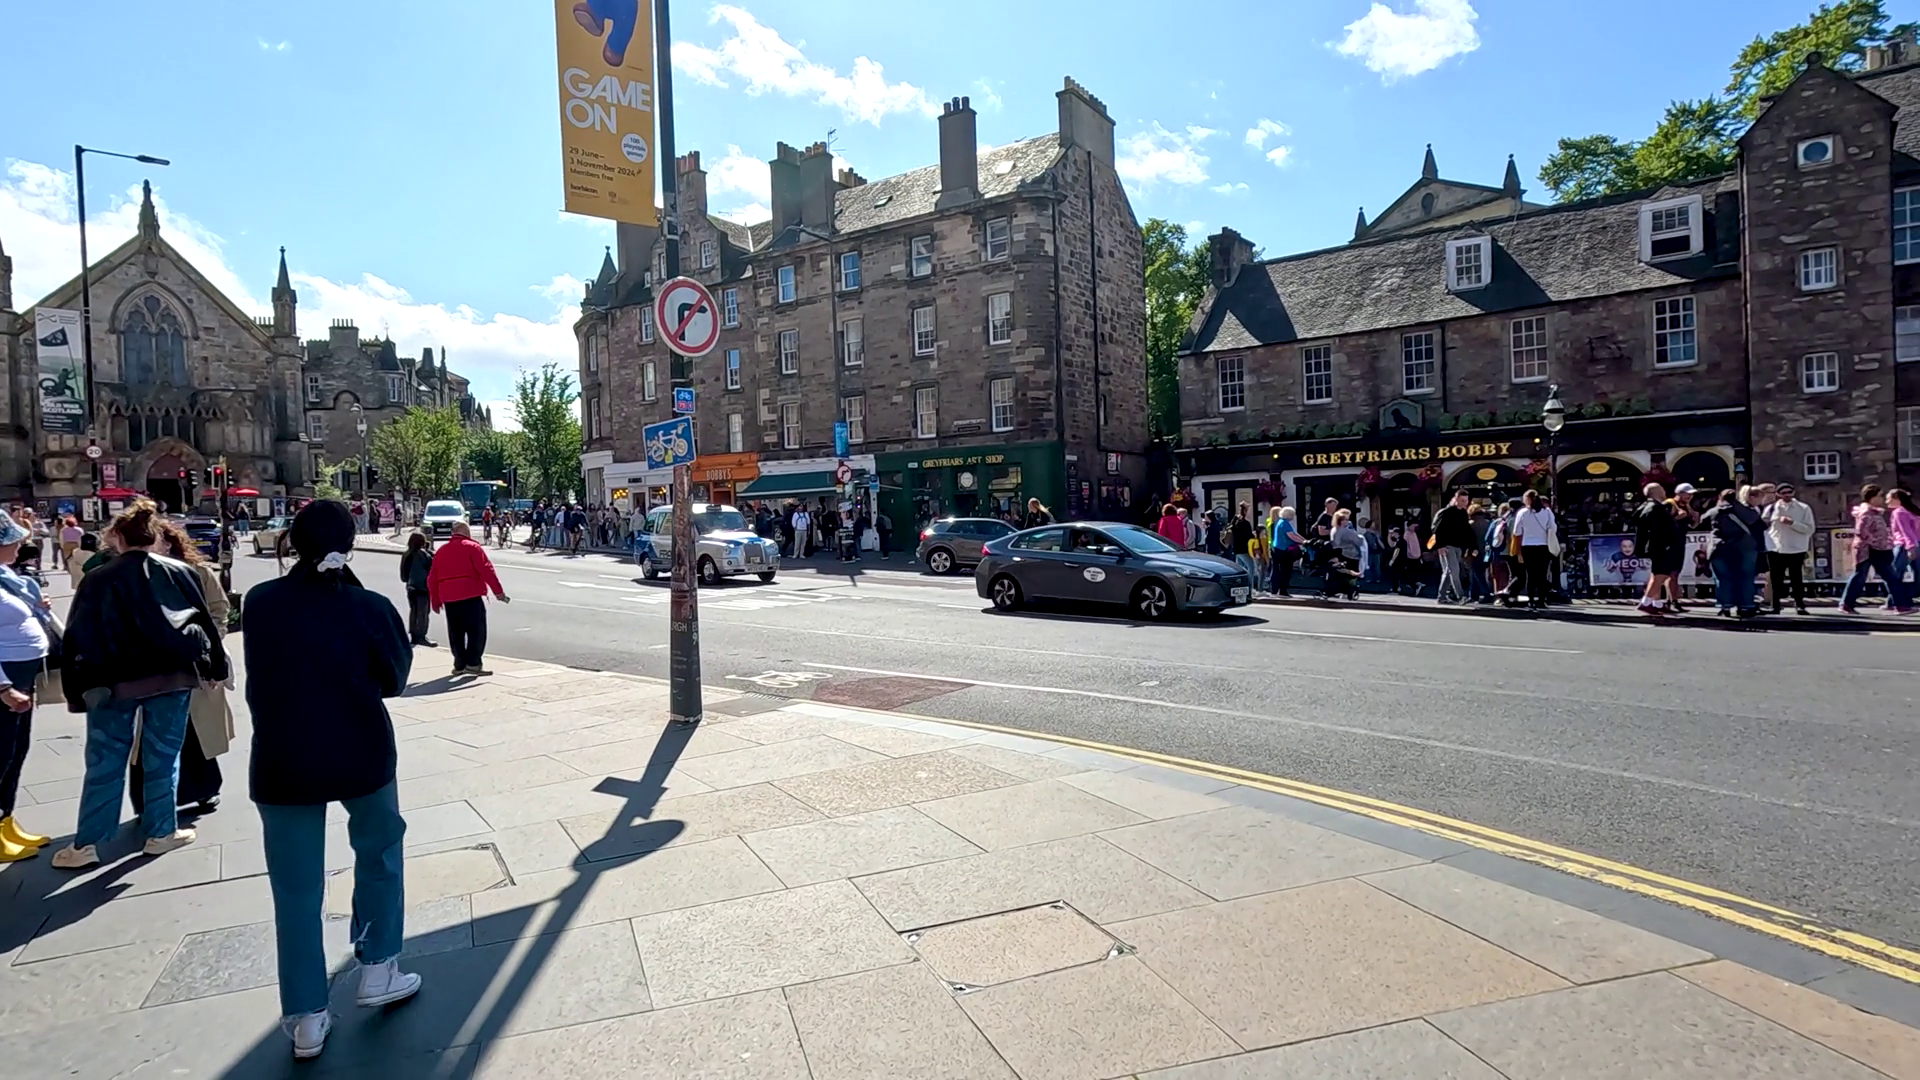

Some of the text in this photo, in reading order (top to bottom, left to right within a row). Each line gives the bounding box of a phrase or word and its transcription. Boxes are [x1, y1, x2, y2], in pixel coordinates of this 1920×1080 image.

[563, 67, 650, 112] GAME
[565, 98, 617, 134] ON
[569, 146, 579, 155] 29
[569, 157, 636, 177] 3 November 2024
[570, 167, 614, 182] Members free
[922, 457, 963, 468] GREYFRIARS
[966, 456, 982, 465] ART
[985, 454, 1004, 464] SHOP
[1302, 442, 1512, 465] GREYFRIARS BOBBY
